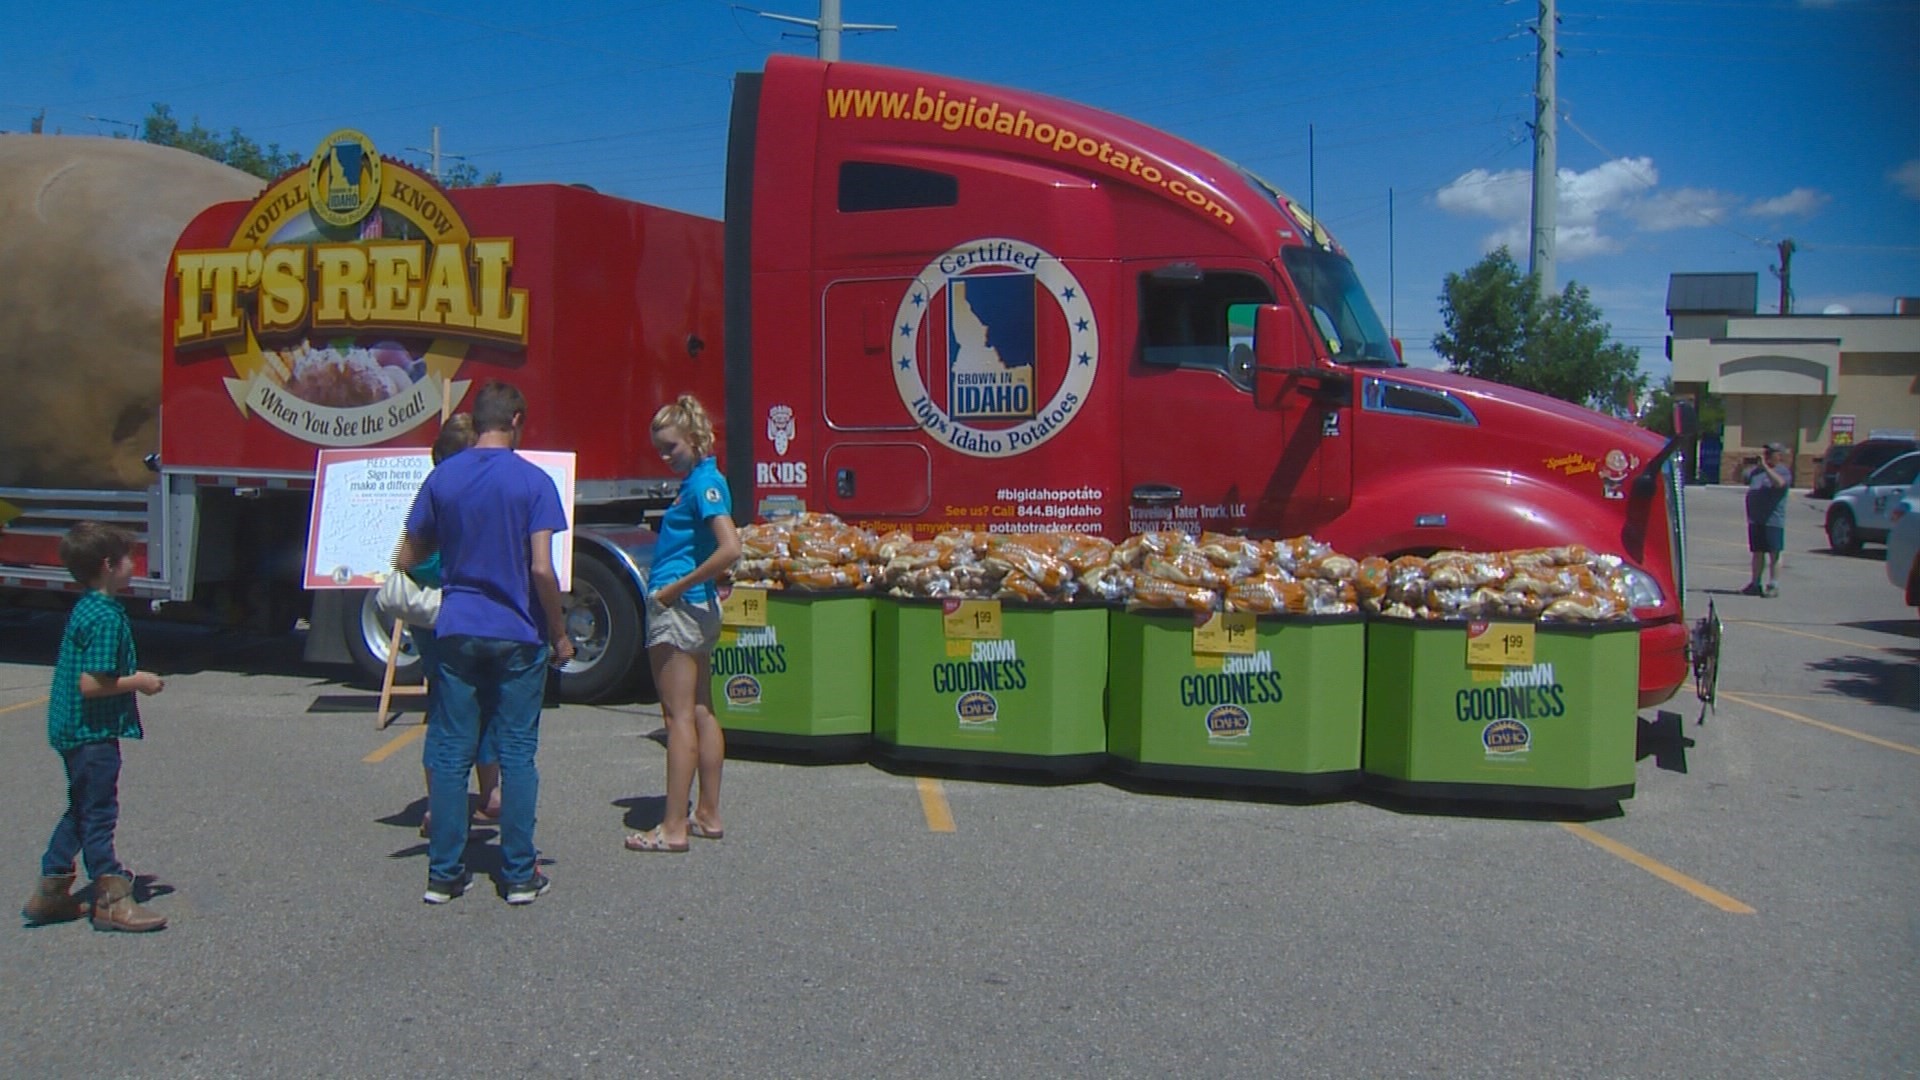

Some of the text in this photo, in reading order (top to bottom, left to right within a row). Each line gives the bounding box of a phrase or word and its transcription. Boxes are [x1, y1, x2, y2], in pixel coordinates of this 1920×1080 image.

[826, 87, 1235, 226] www.bigidahopotato.com
[244, 184, 307, 244] YOU'LL
[391, 179, 454, 236] KNOW
[939, 242, 1040, 275] Certified
[175, 237, 529, 346] IT'S REAL
[957, 372, 1012, 385] GROWN IN
[261, 387, 426, 437] When You See the Seal!
[957, 384, 1029, 414] IDAHO
[912, 391, 1079, 453] 100% Idaho Potatoes
[350, 480, 376, 491] make
[379, 483, 385, 491] a
[367, 469, 422, 481] Sign here to
[997, 487, 1102, 502] #bigidahopotato
[945, 504, 1102, 519] See us? Call 844.BigIdaho
[1174, 504, 1198, 518] Tater
[1230, 503, 1246, 517] LLC
[860, 520, 897, 533] Follow
[989, 521, 1102, 534] potatotracker.com
[970, 639, 1016, 662] GROWN
[933, 659, 1027, 694] GOODNESS
[1180, 671, 1283, 707] GOODNESS
[1456, 684, 1565, 722] GOODNESS
